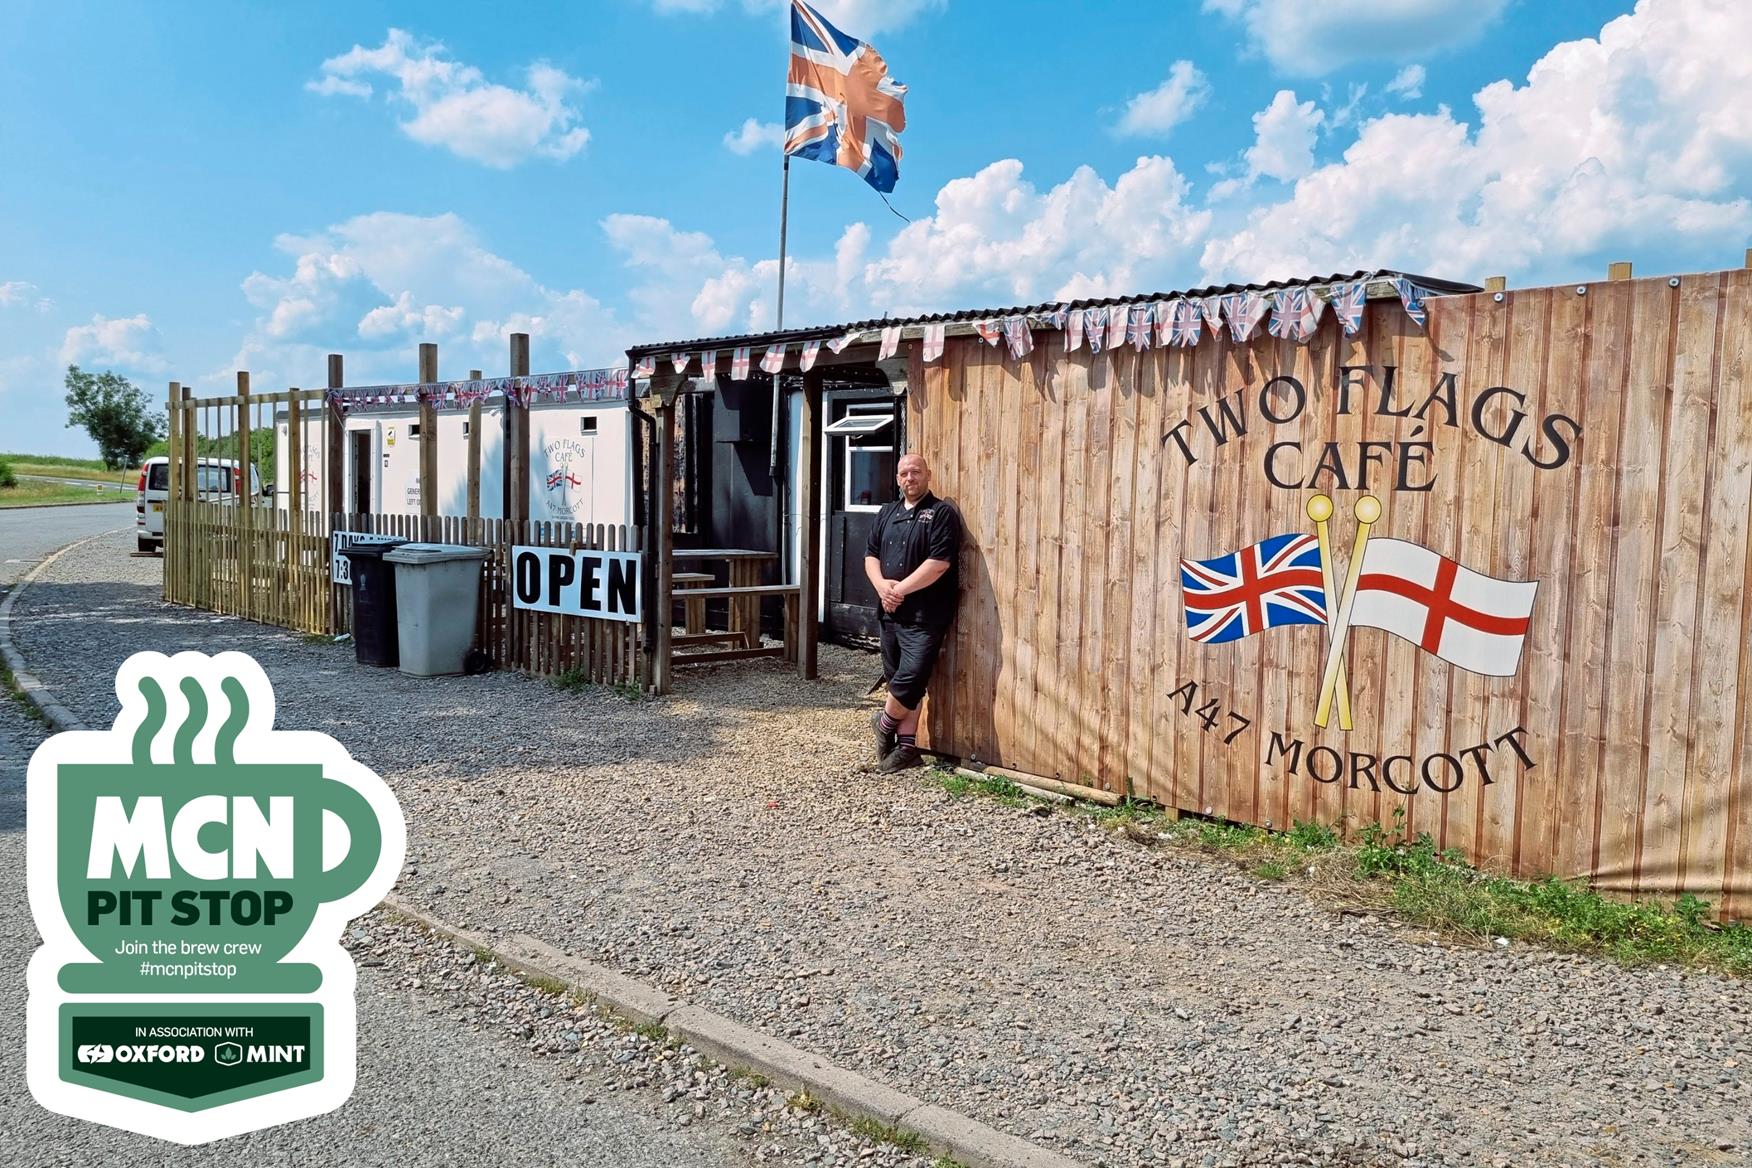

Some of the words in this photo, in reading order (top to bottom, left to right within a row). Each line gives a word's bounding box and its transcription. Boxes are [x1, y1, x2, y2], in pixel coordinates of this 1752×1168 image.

[544, 440, 561, 458] TWO
[562, 438, 586, 458] FLAGS
[1161, 375, 1306, 467] TWO
[1336, 365, 1583, 470] FLAGS
[1263, 424, 1438, 492] CAFÉ
[557, 497, 584, 515] MORCOTT
[335, 559, 353, 580] 7:3
[516, 551, 637, 615] OPEN
[1166, 679, 1251, 746] A47
[1265, 725, 1538, 795] MORCOTT
